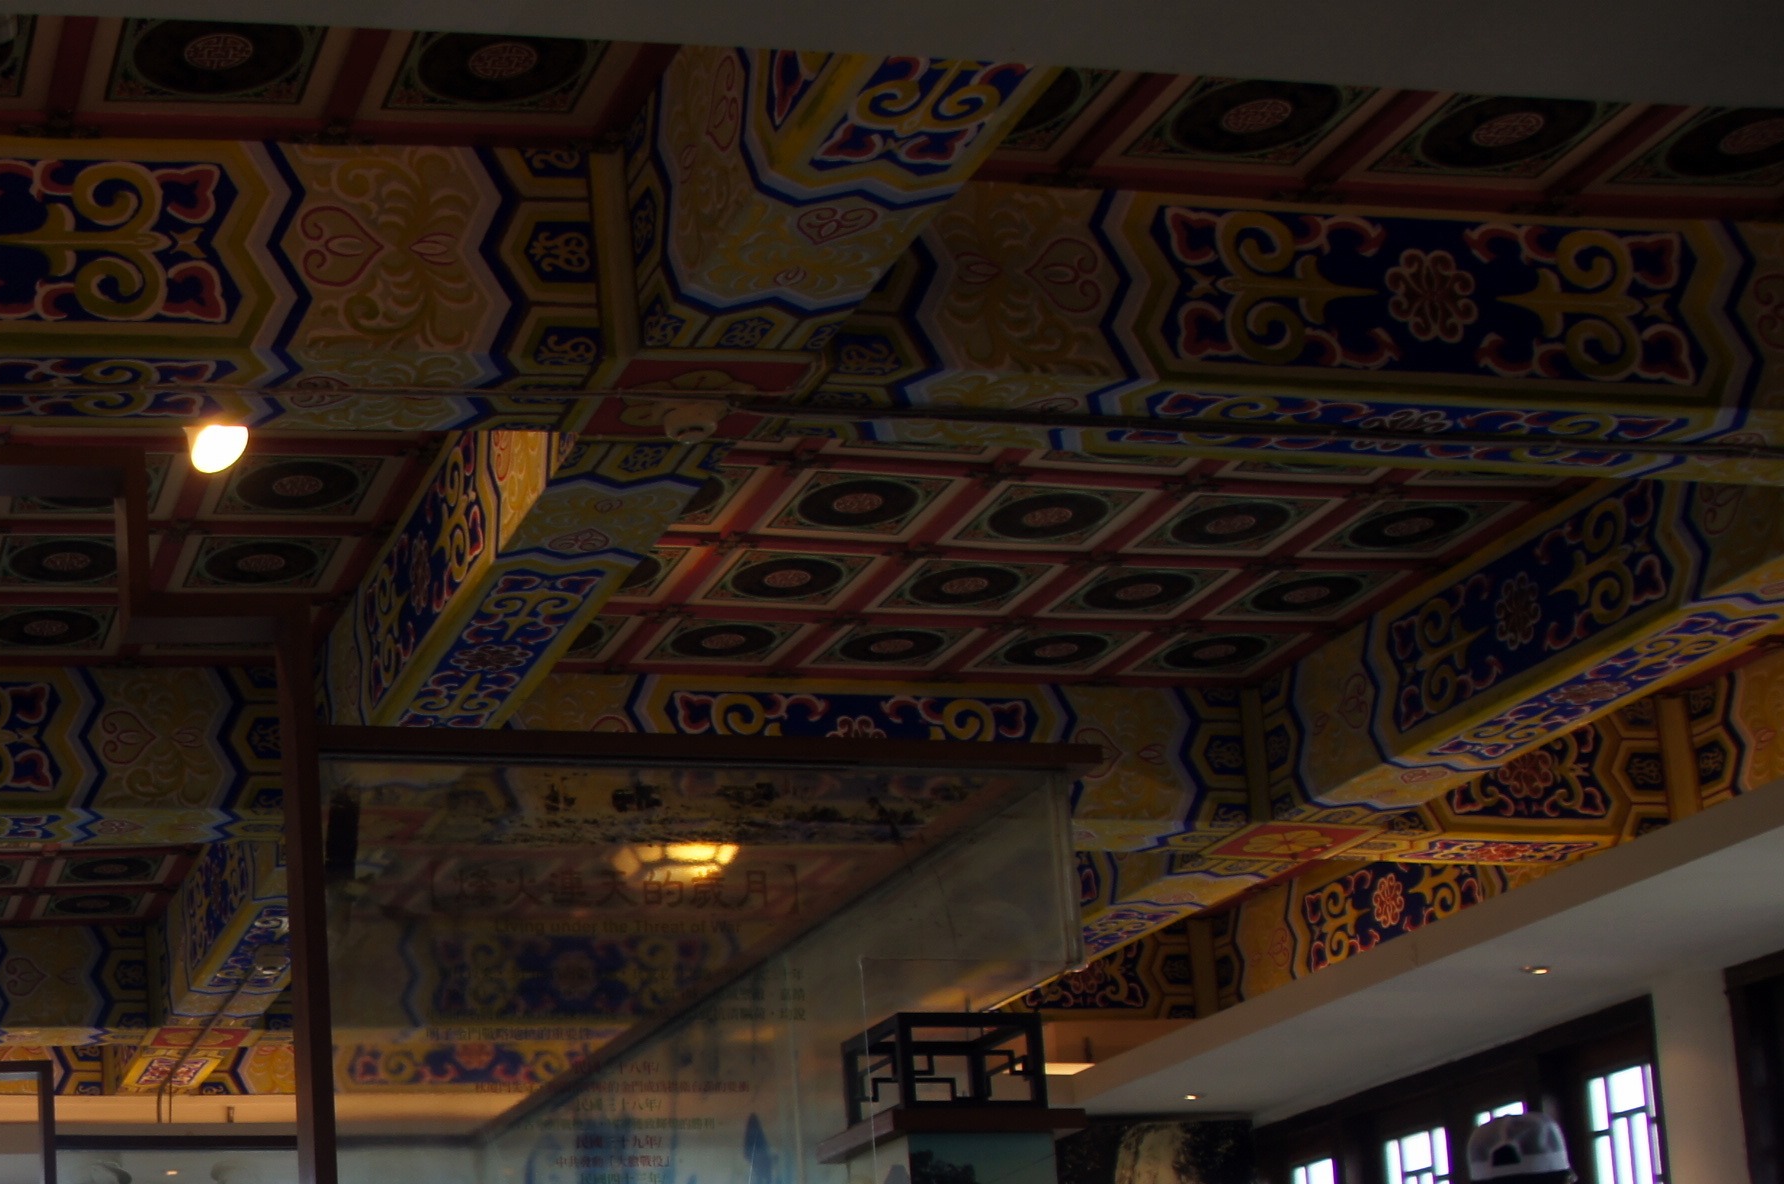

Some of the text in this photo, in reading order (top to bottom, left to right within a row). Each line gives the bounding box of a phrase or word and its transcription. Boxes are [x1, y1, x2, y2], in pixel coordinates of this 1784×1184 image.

[494, 919, 742, 936] Living under the Threat of War
